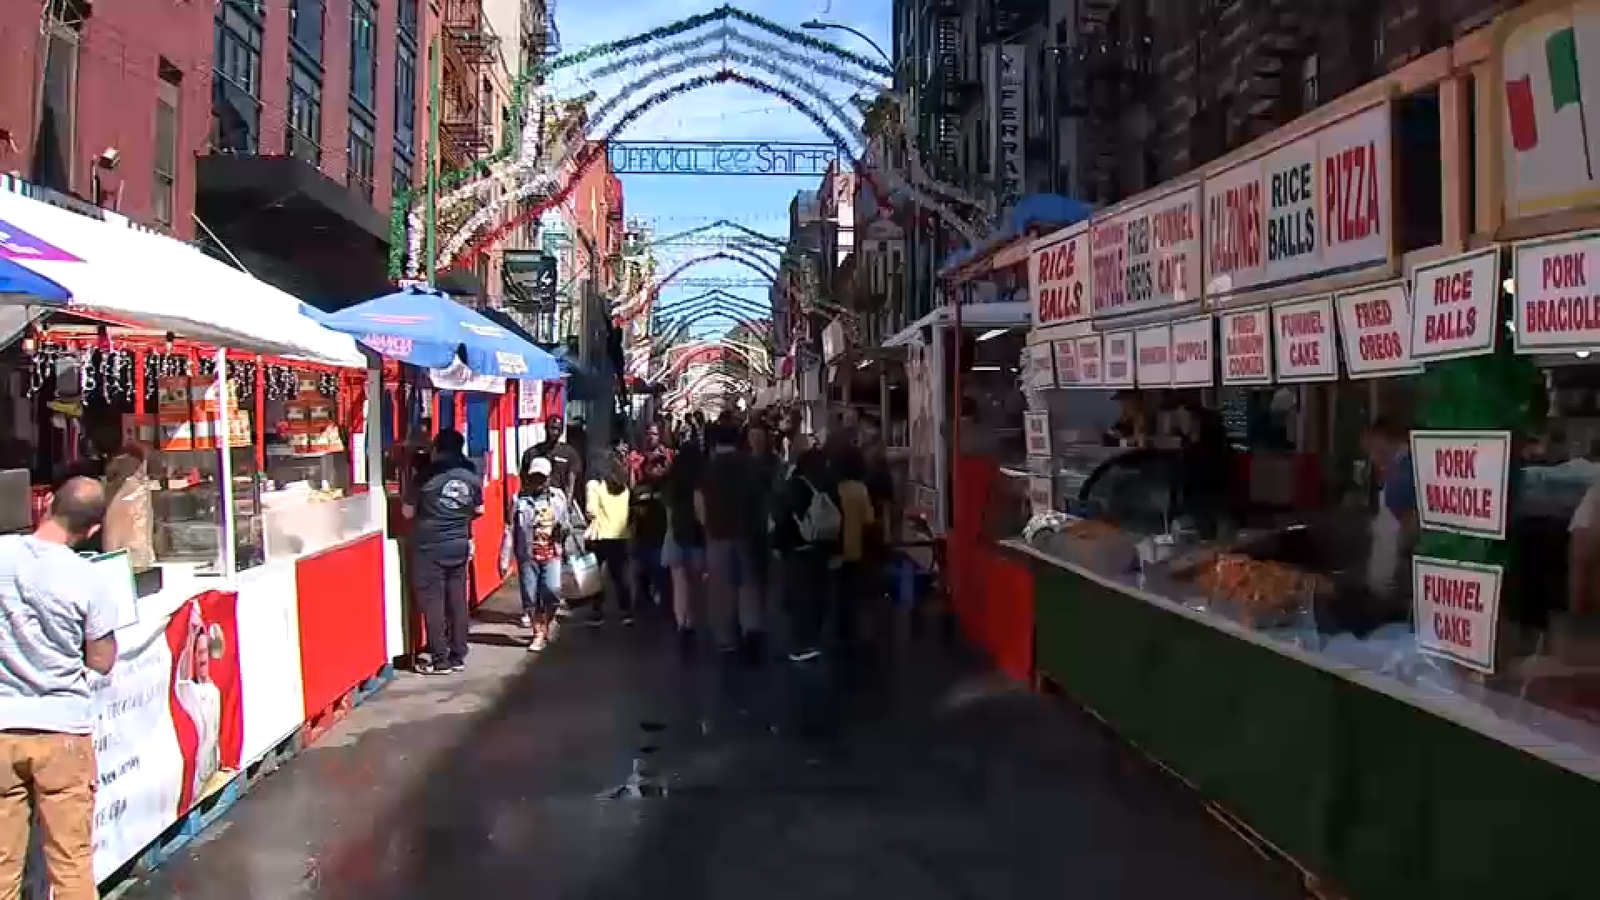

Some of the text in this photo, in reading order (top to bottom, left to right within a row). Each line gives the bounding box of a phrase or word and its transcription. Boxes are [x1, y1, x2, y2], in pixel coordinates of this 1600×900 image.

[1271, 162, 1312, 208] RICE
[1325, 140, 1381, 247] PIZZA
[1268, 206, 1315, 261] BALLS
[1038, 240, 1077, 285] RICE
[1542, 252, 1586, 290] PORK
[1038, 281, 1083, 323] BALLS
[1433, 269, 1474, 306] RICE
[1280, 309, 1325, 337] FUNNEL
[1353, 299, 1393, 328] FRIED
[1425, 305, 1477, 344] BALLS
[1526, 294, 1600, 334] BRACIOLE
[1289, 340, 1320, 367] CAKE
[1358, 332, 1403, 361] OREOS
[1434, 447, 1478, 479] PORK
[1425, 483, 1493, 519] BRACIOLE
[1423, 573, 1484, 614] FUNNEL
[1432, 612, 1472, 648] CAKE
